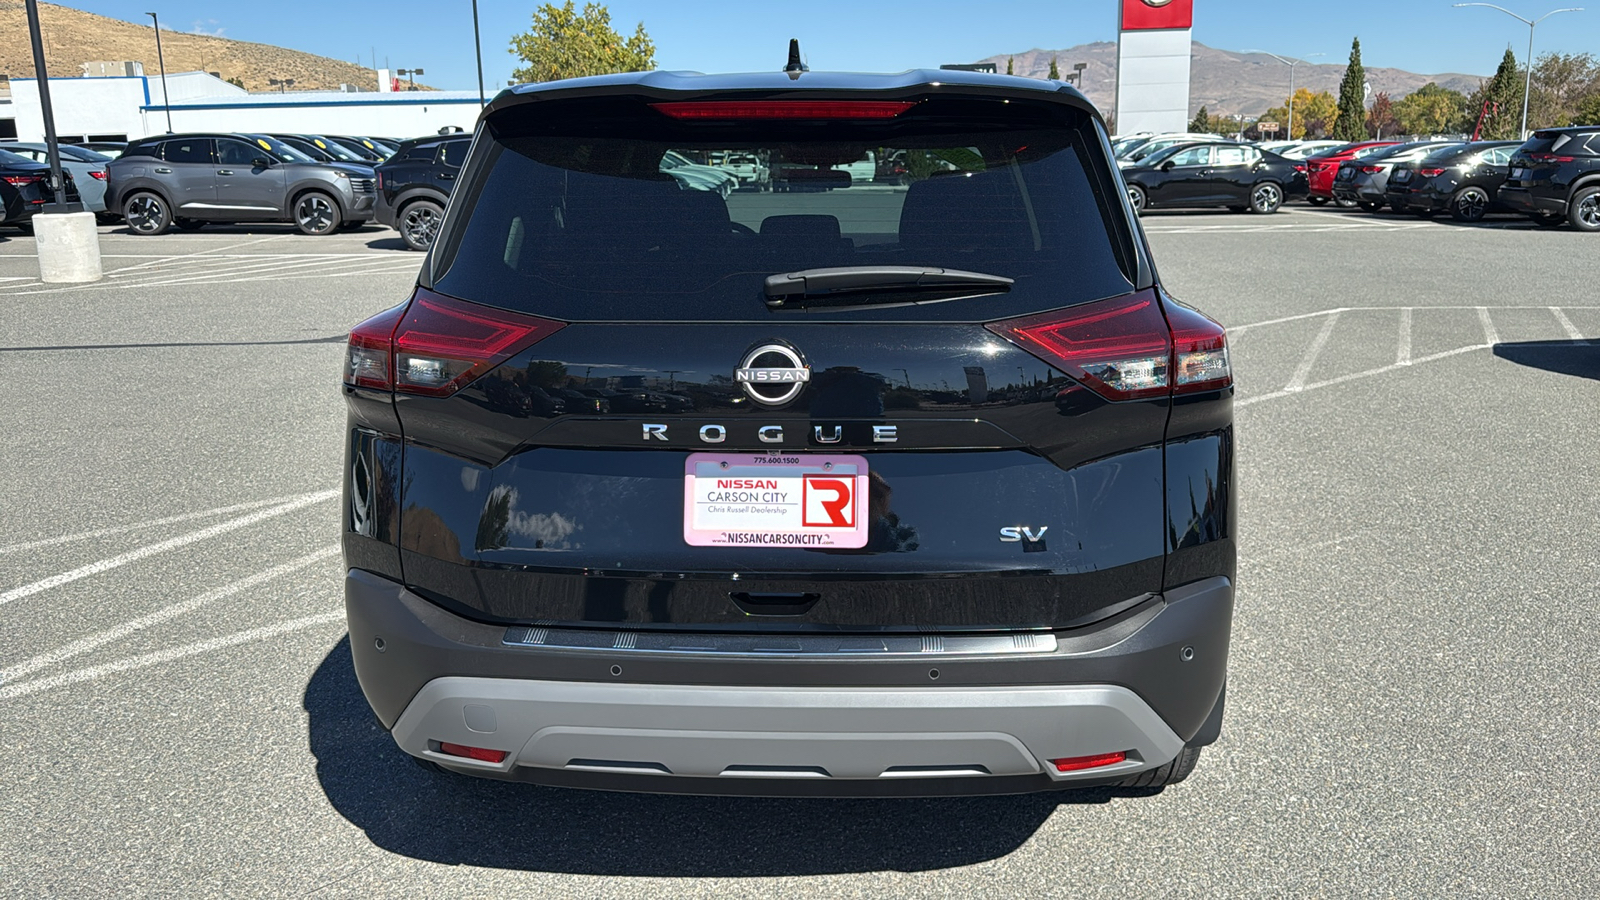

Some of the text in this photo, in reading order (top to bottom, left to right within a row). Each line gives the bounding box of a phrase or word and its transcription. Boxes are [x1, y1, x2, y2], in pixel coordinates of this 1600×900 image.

[737, 370, 809, 381] NISSAN
[642, 423, 898, 443] ROGUE
[717, 479, 778, 489] NISSAN
[707, 491, 788, 503] CARSON CITY
[708, 505, 788, 515] Chris Russell Dealership
[999, 526, 1048, 542] SV
